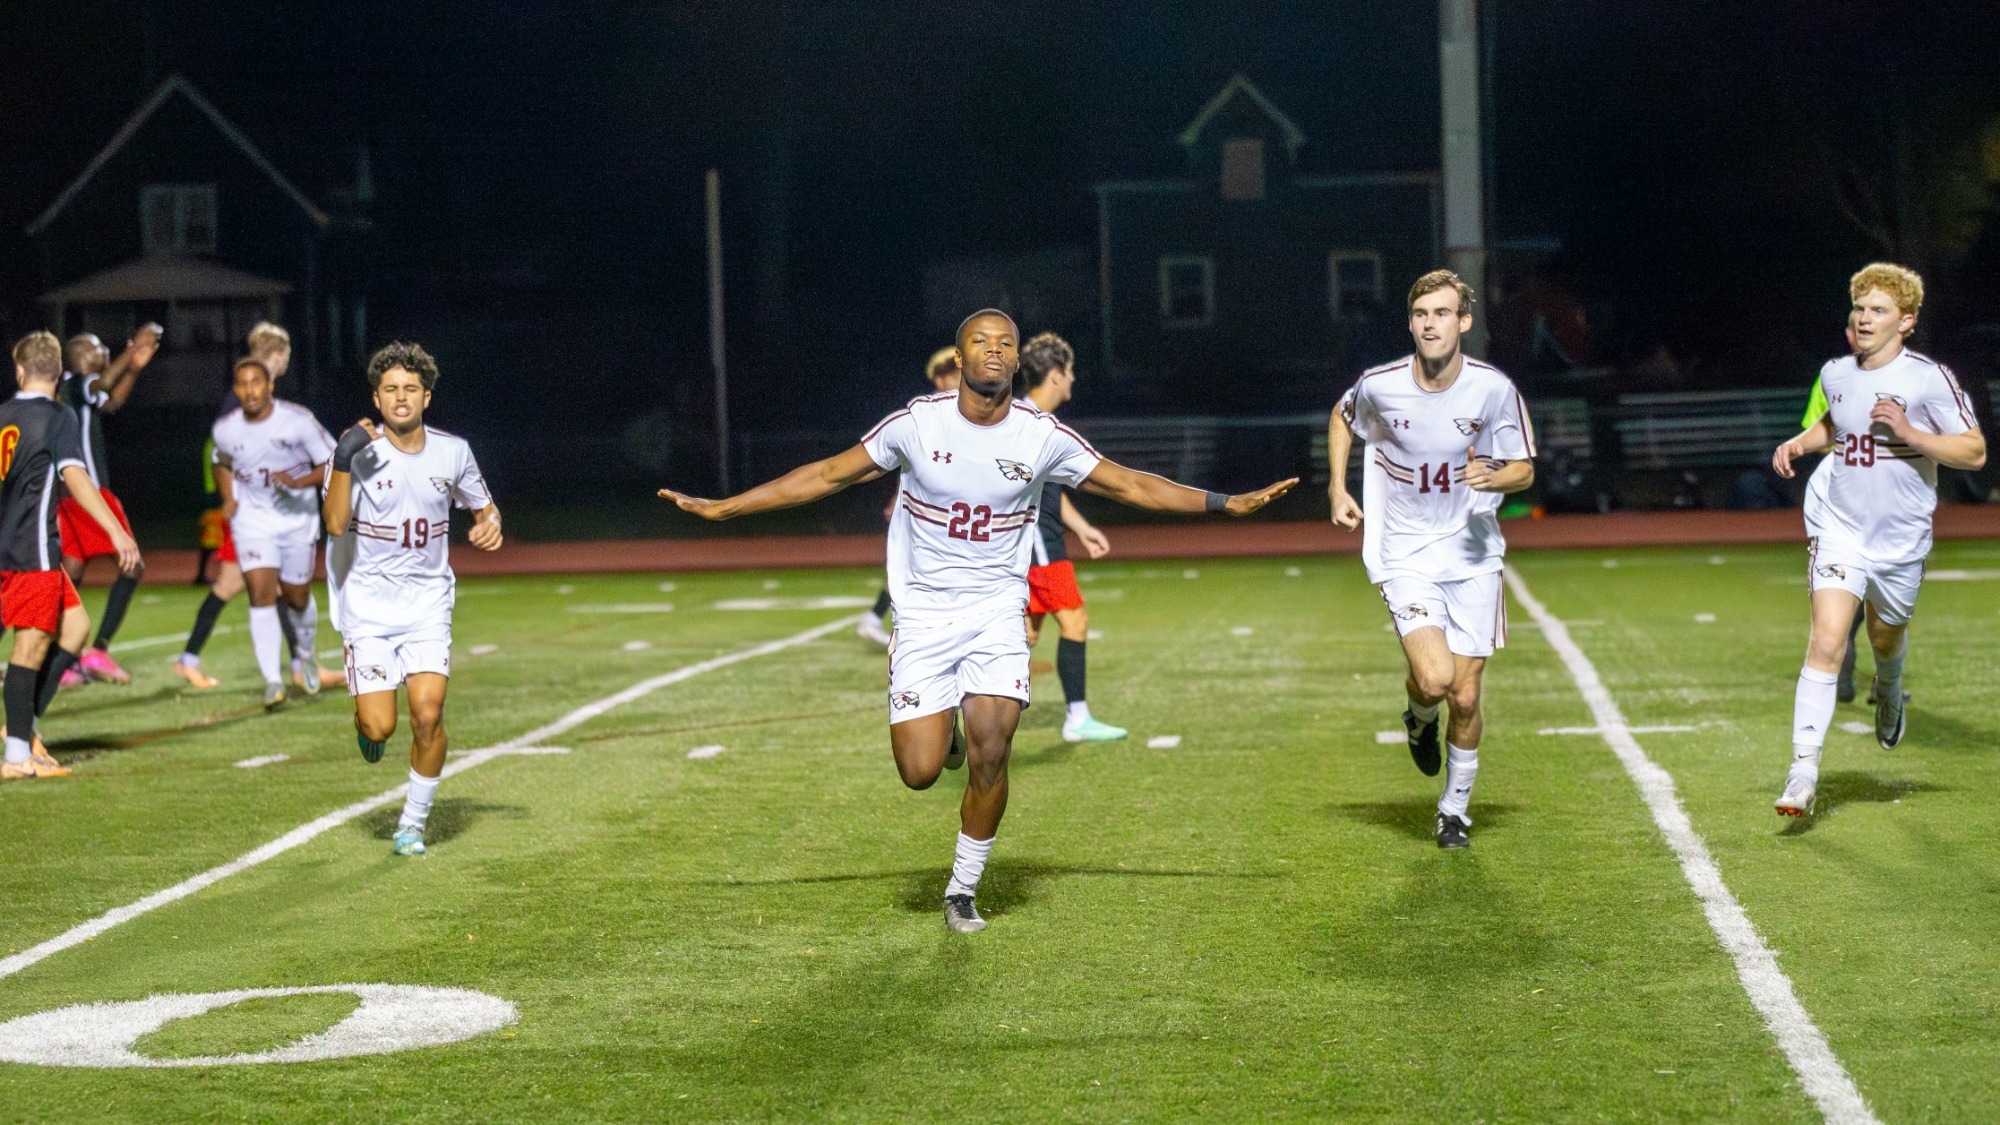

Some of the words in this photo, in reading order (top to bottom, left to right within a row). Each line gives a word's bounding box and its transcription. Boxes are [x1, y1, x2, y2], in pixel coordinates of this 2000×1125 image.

[1845, 433, 1875, 468] 29
[1419, 462, 1450, 493] 14
[402, 518, 429, 549] 19
[948, 501, 992, 542] 22
